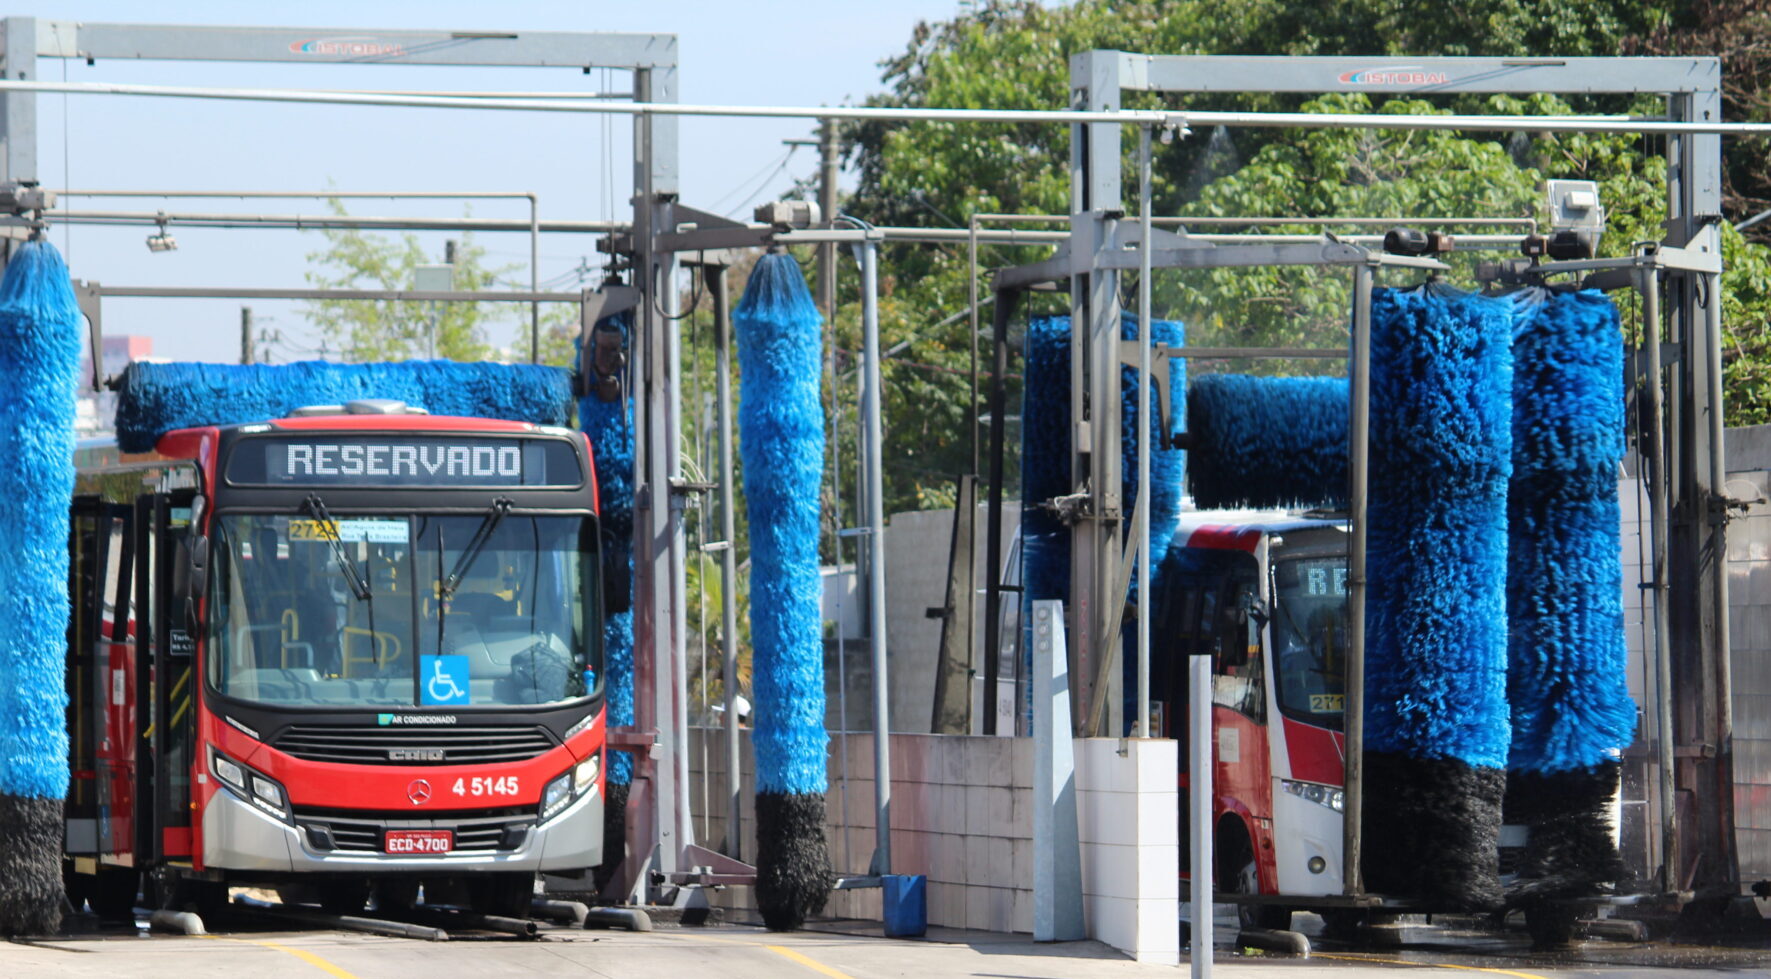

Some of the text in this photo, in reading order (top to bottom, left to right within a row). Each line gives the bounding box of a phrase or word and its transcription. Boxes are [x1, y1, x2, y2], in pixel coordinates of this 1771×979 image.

[1365, 71, 1451, 86] ISTOBAL
[287, 444, 521, 476] RESERVADO
[391, 715, 457, 725] AR CONDICIONADO
[452, 776, 519, 797] 4 5145
